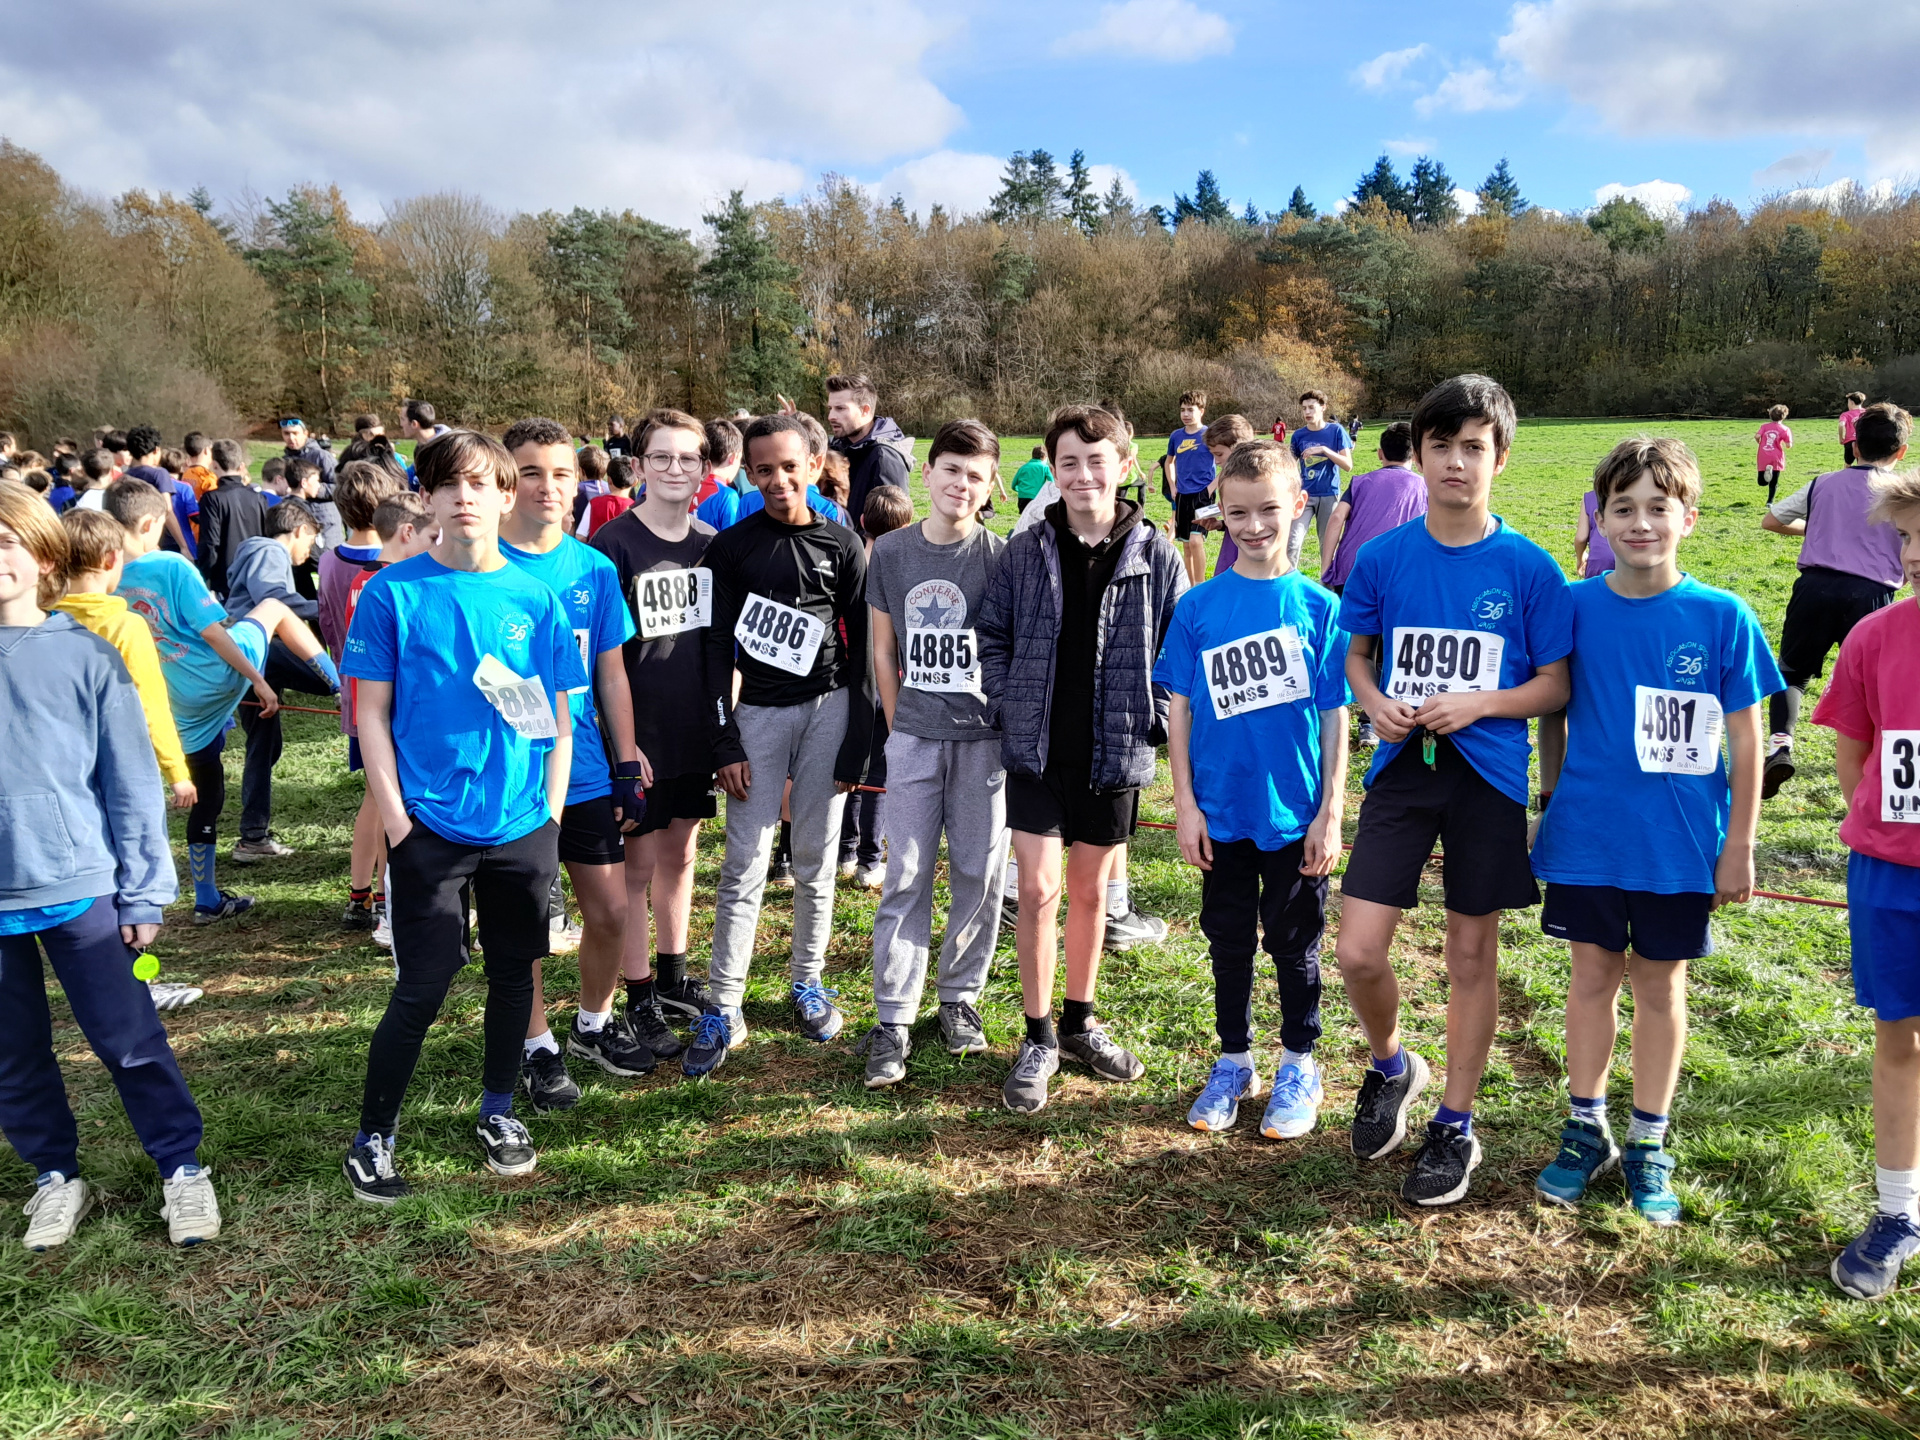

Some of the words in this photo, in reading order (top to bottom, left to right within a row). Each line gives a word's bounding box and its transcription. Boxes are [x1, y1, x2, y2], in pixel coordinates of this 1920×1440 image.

[643, 573, 698, 612] 4888
[910, 585, 960, 606] CONVERSE
[646, 612, 687, 628] UNSS
[742, 601, 809, 650] 4886
[910, 633, 971, 669] 4885
[1212, 636, 1287, 690] 4889
[1397, 633, 1481, 681] 4890
[911, 671, 952, 684] UNSS
[1217, 684, 1269, 709] UNSS
[1223, 708, 1233, 716] 35
[1642, 695, 1696, 743] 4881
[1893, 738, 1920, 790] 3
[1892, 812, 1904, 820] 35
